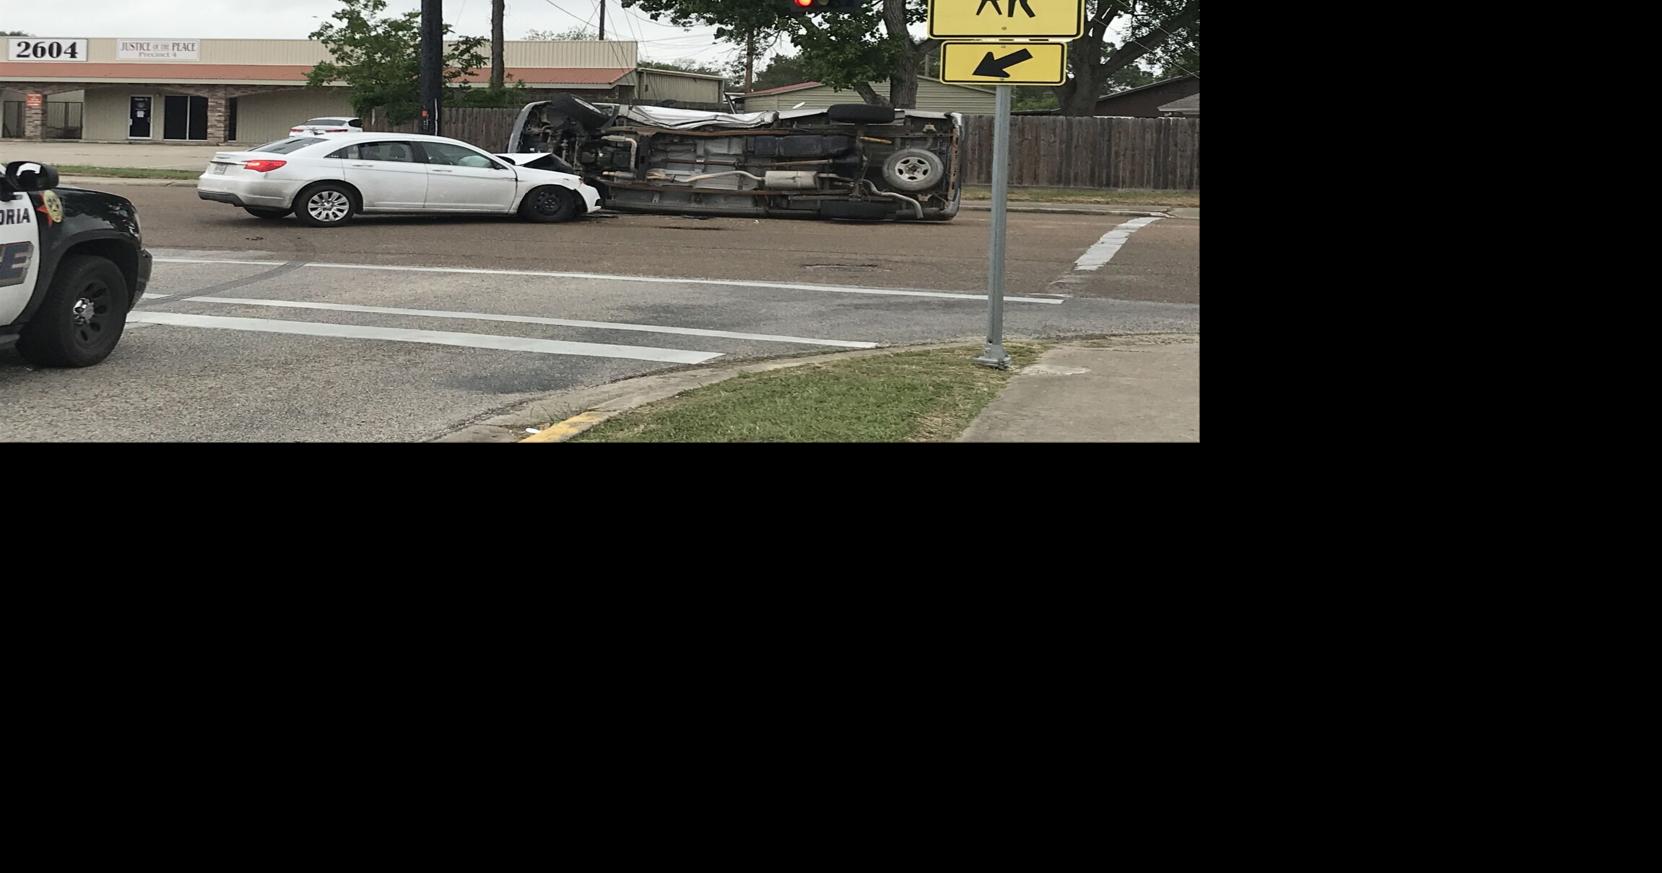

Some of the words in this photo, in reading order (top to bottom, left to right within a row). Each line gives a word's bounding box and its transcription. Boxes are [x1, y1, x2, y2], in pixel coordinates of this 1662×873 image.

[16, 41, 78, 58] 2604
[120, 42, 151, 51] JUSTICE
[172, 42, 196, 51] PEACE
